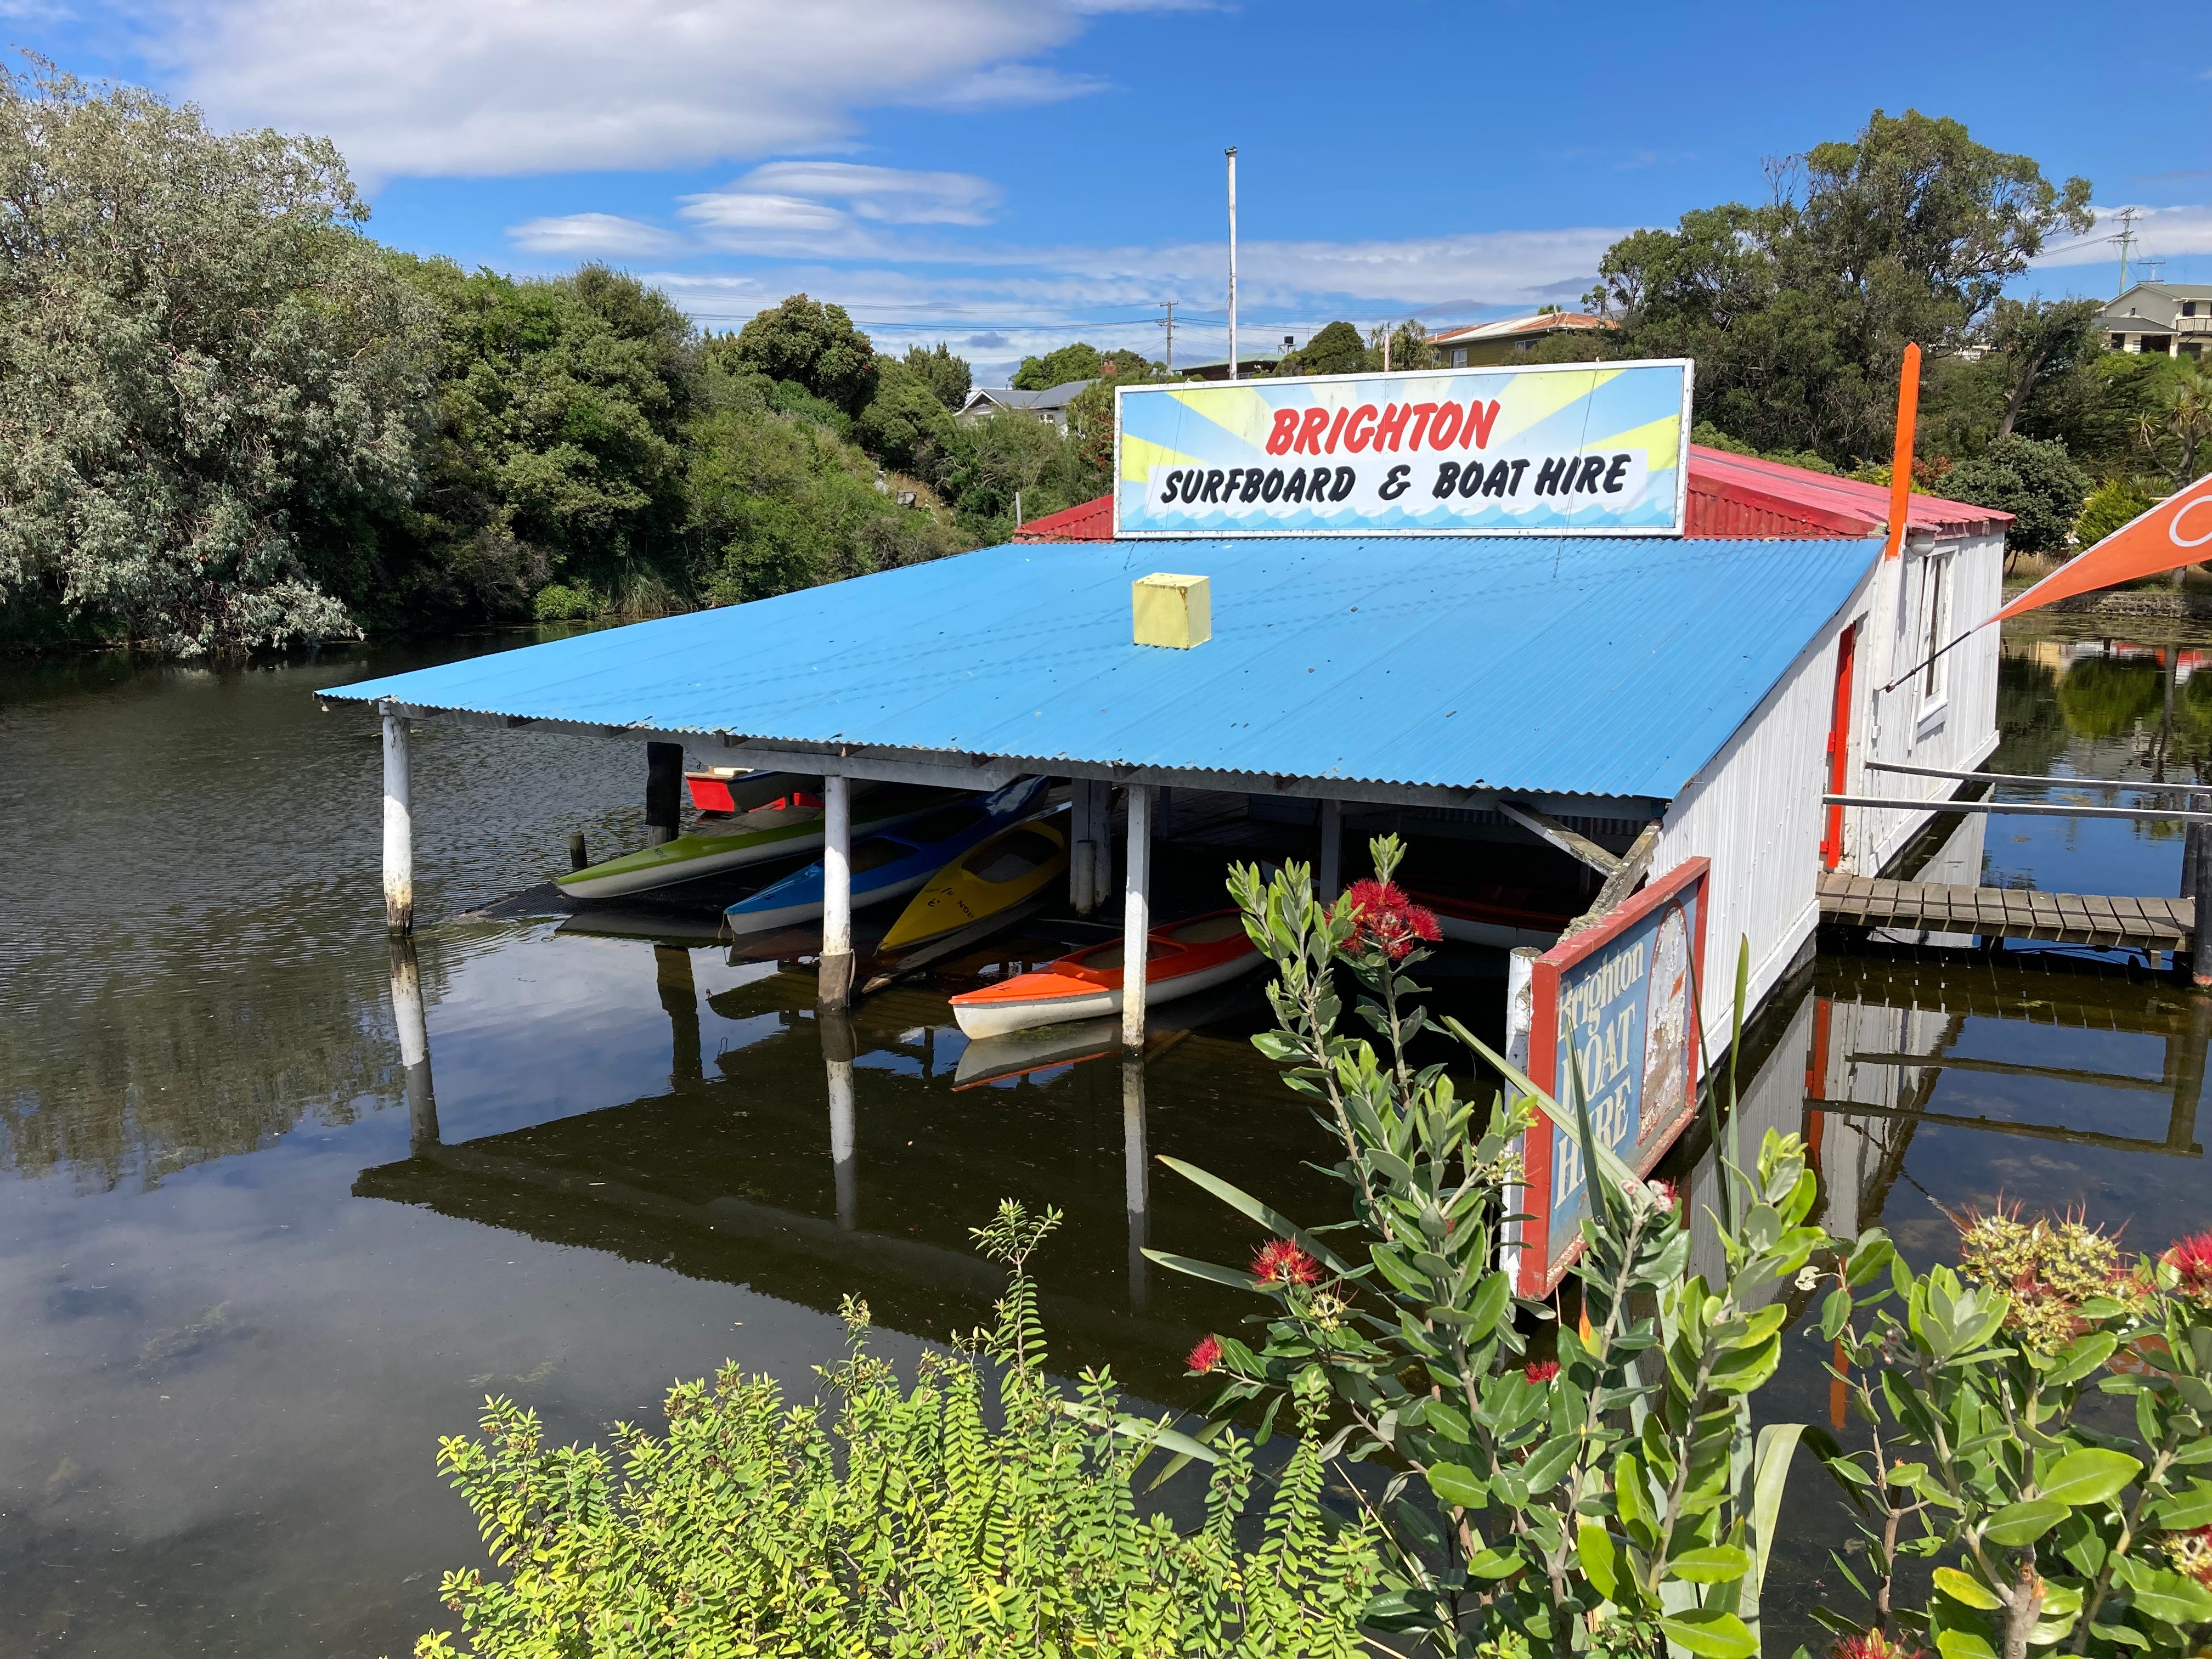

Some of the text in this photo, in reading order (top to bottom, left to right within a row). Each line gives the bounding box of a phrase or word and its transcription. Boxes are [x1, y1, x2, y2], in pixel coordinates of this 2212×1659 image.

[1265, 399, 1501, 456] BRIGHTON
[1160, 454, 1632, 504] SURFBOARD & BOAT HIRE
[1557, 940, 1644, 1043] Brighton
[1554, 1071, 1632, 1210] HRE
